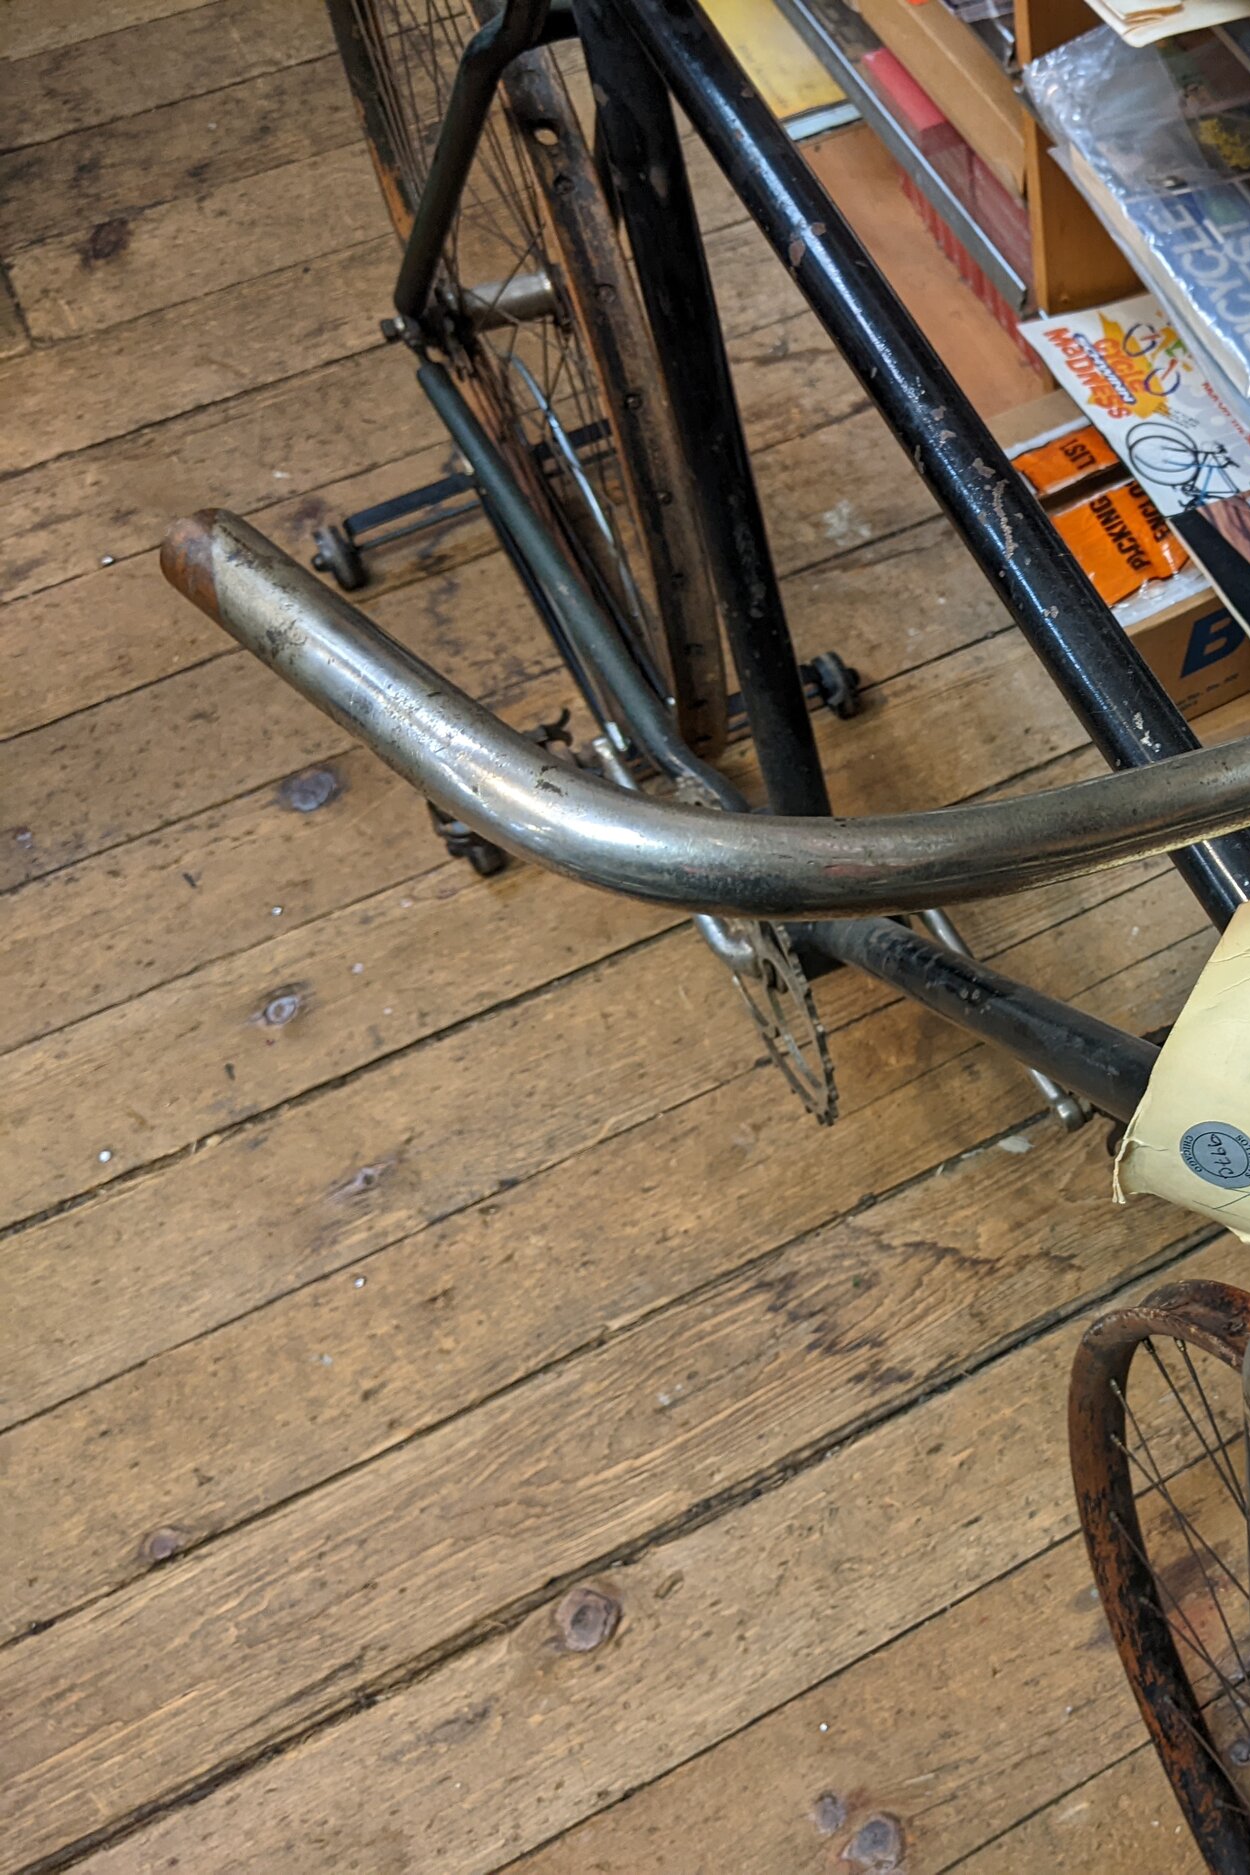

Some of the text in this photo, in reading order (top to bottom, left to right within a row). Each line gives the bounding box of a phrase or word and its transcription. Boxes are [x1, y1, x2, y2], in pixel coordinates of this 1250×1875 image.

[1075, 335, 1134, 403] SCHWINN
[1059, 438, 1097, 470] LIST
[1089, 495, 1152, 573] PACKING
[1183, 1135, 1203, 1173] CHICAGO
